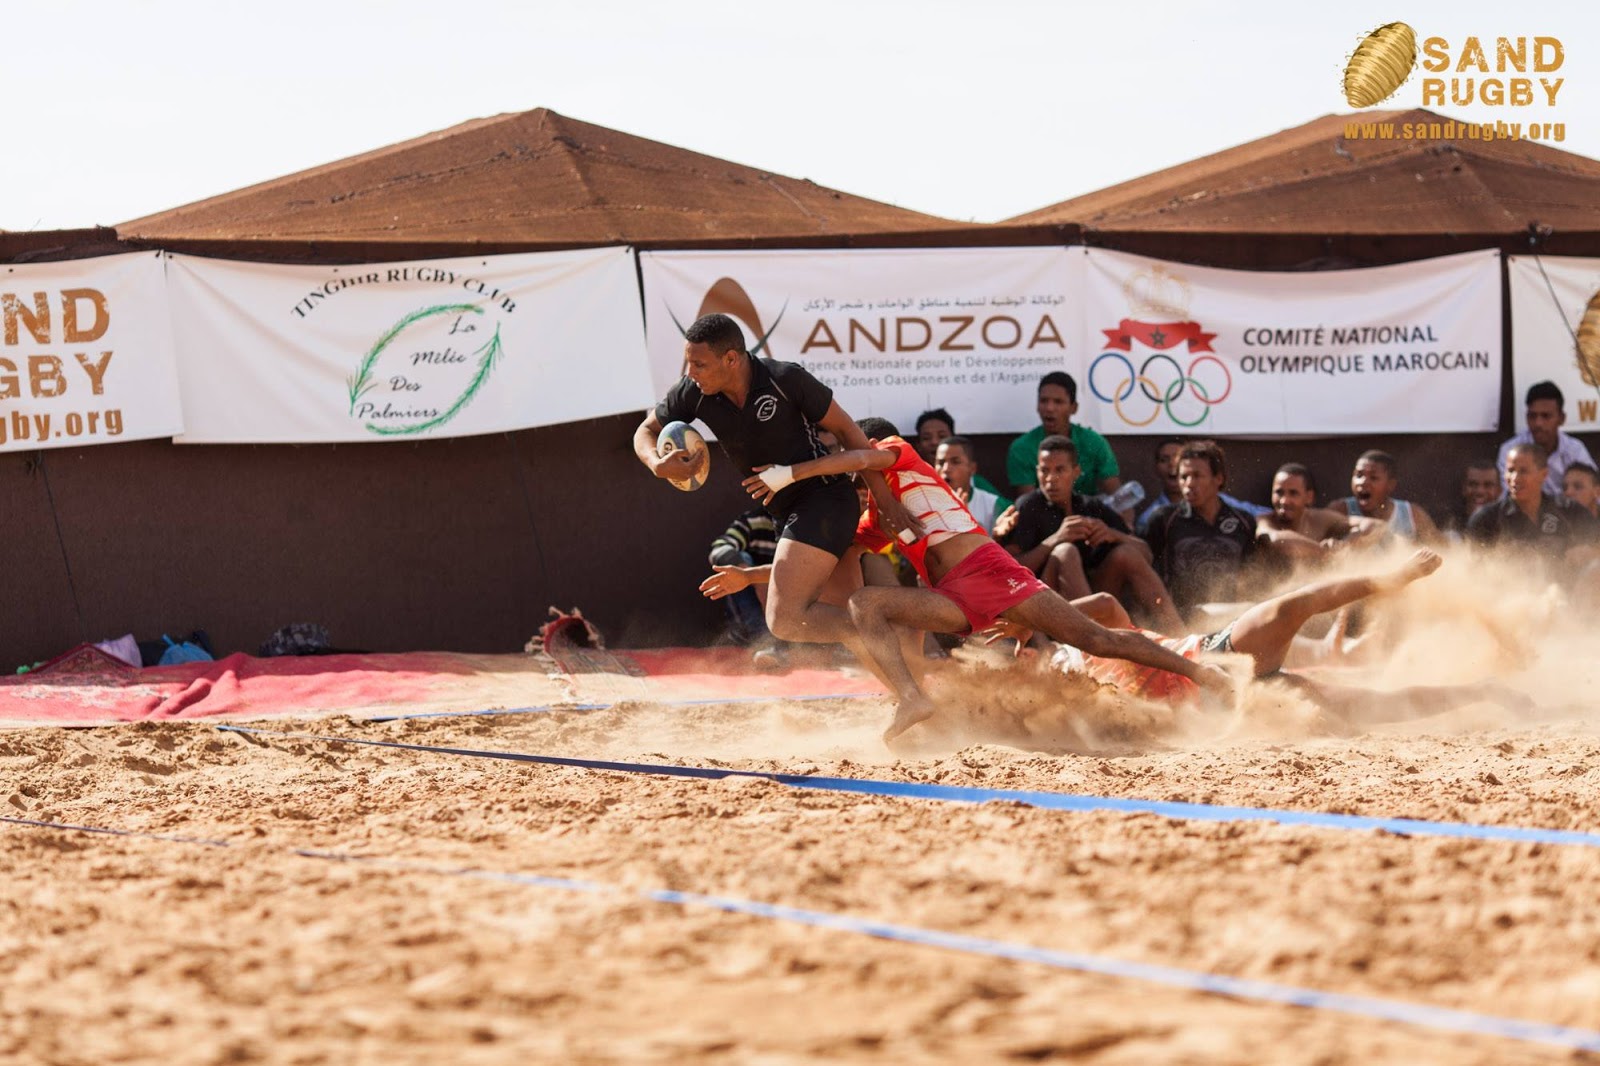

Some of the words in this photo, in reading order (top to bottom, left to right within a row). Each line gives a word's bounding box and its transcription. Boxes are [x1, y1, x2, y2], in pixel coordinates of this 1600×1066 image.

[387, 267, 461, 285] RUGBY
[463, 278, 516, 313] CLUB
[449, 315, 476, 335] La
[800, 314, 1066, 354] ANDZOA
[1243, 323, 1325, 346] COMITÉ
[1331, 325, 1439, 345] NATIONAL
[850, 359, 912, 370] Nationale
[916, 359, 945, 373] pour
[949, 357, 961, 368] le
[965, 355, 1065, 369] Développement
[1240, 354, 1365, 376] OLYMPIQUE
[1372, 351, 1489, 372] MAROCAIN
[389, 376, 422, 392] Des
[842, 375, 880, 387] Zones
[884, 374, 950, 386] Oasiennes
[954, 374, 966, 384] et
[971, 373, 987, 384] de
[355, 402, 440, 419] Palmiers
